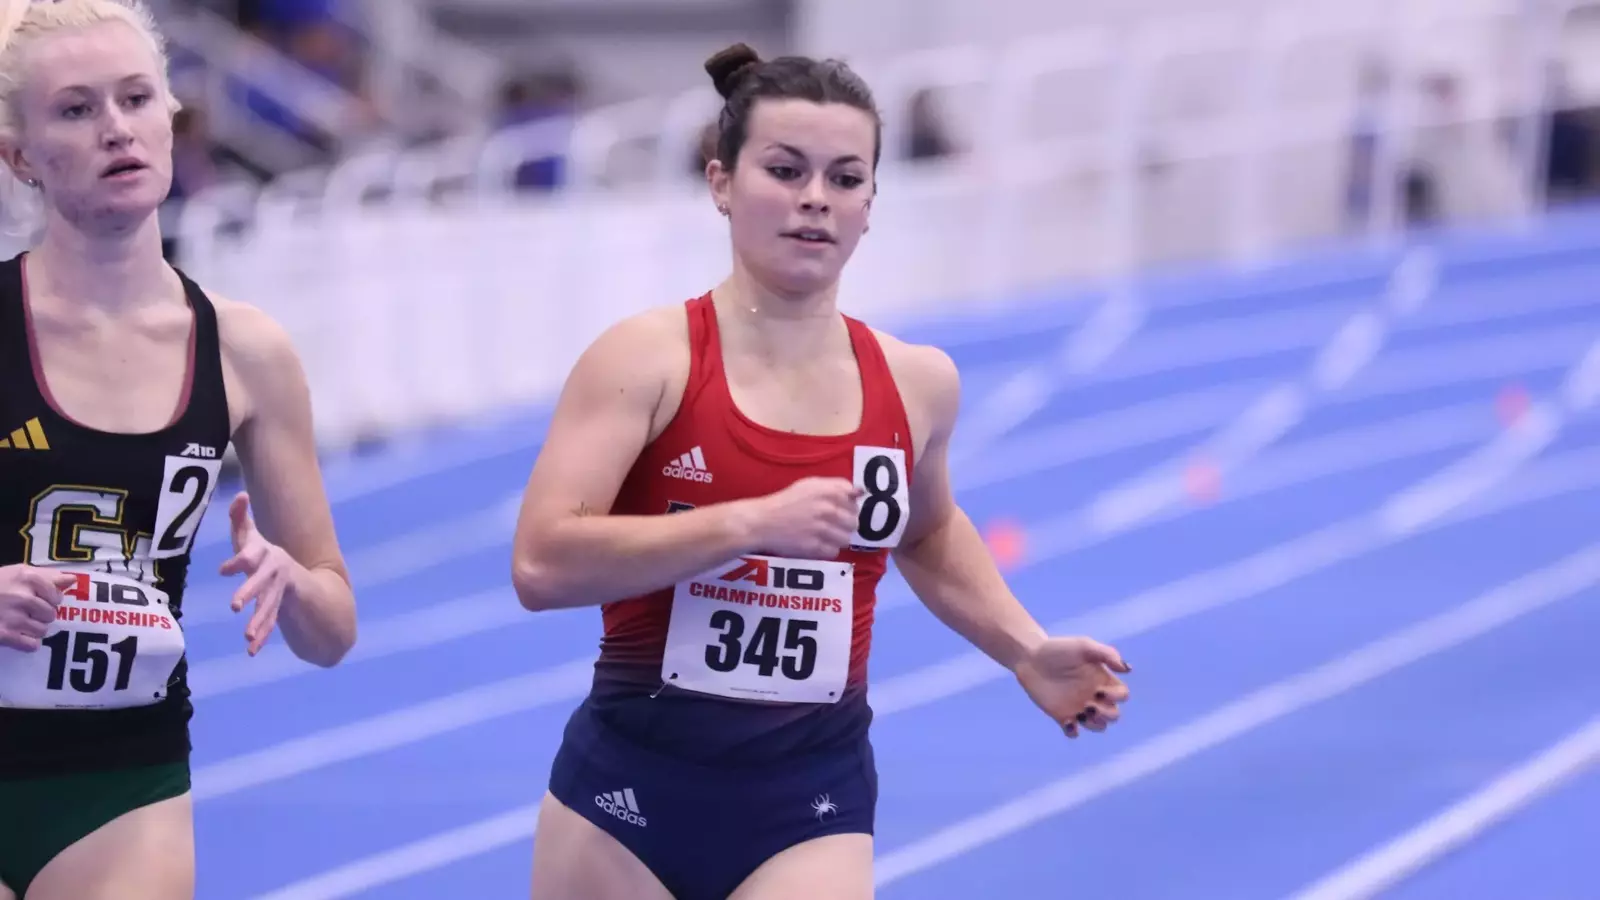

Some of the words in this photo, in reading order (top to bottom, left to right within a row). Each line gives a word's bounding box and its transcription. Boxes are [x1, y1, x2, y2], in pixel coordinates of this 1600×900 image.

[180, 443, 216, 458] A10
[662, 465, 713, 484] adidas
[157, 465, 209, 551] 2
[858, 455, 901, 542] 8
[720, 557, 825, 591] A10
[689, 581, 842, 613] CHAMPIONSHIPS
[55, 604, 172, 630] MPIONSHIPS
[42, 630, 138, 693] 151
[704, 609, 819, 681] 345
[594, 795, 648, 828] adidas
